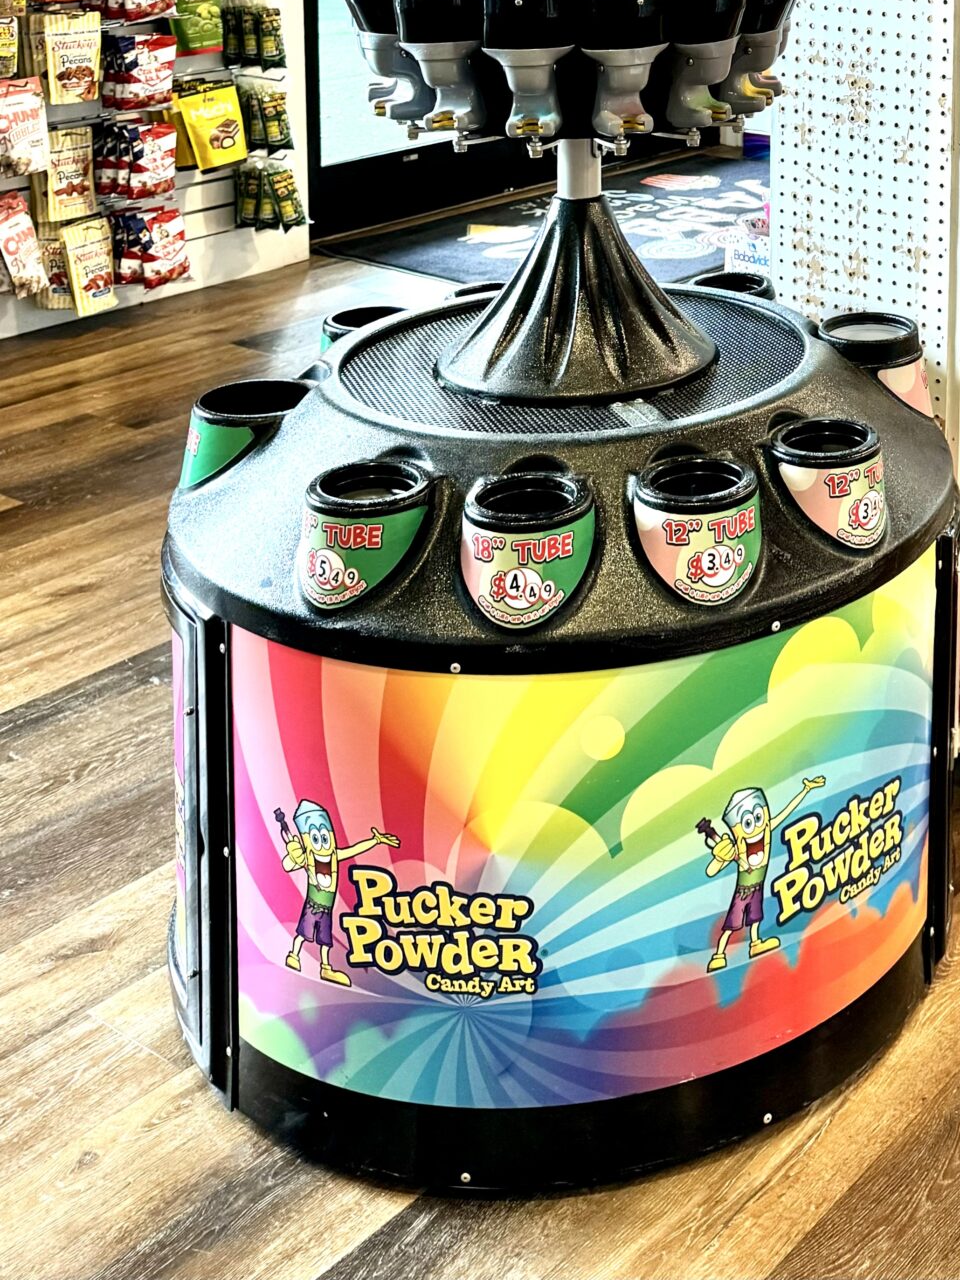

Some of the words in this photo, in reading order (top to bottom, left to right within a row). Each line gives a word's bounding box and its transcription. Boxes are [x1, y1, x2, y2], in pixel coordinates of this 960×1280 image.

[60, 55, 93, 67] Pecans
[322, 522, 383, 549] TUBE
[663, 519, 701, 544] 12"
[710, 506, 755, 542] TUBE
[472, 533, 506, 561] 18"
[512, 532, 574, 564] TUBE
[687, 547, 744, 583] $3.49
[490, 570, 554, 602] $4.49
[784, 778, 900, 871] Pucker
[840, 864, 882, 904] Candy
[882, 847, 902, 873] Art
[352, 869, 529, 929] Pucker
[425, 973, 495, 998] Candy
[496, 977, 536, 993] Art
